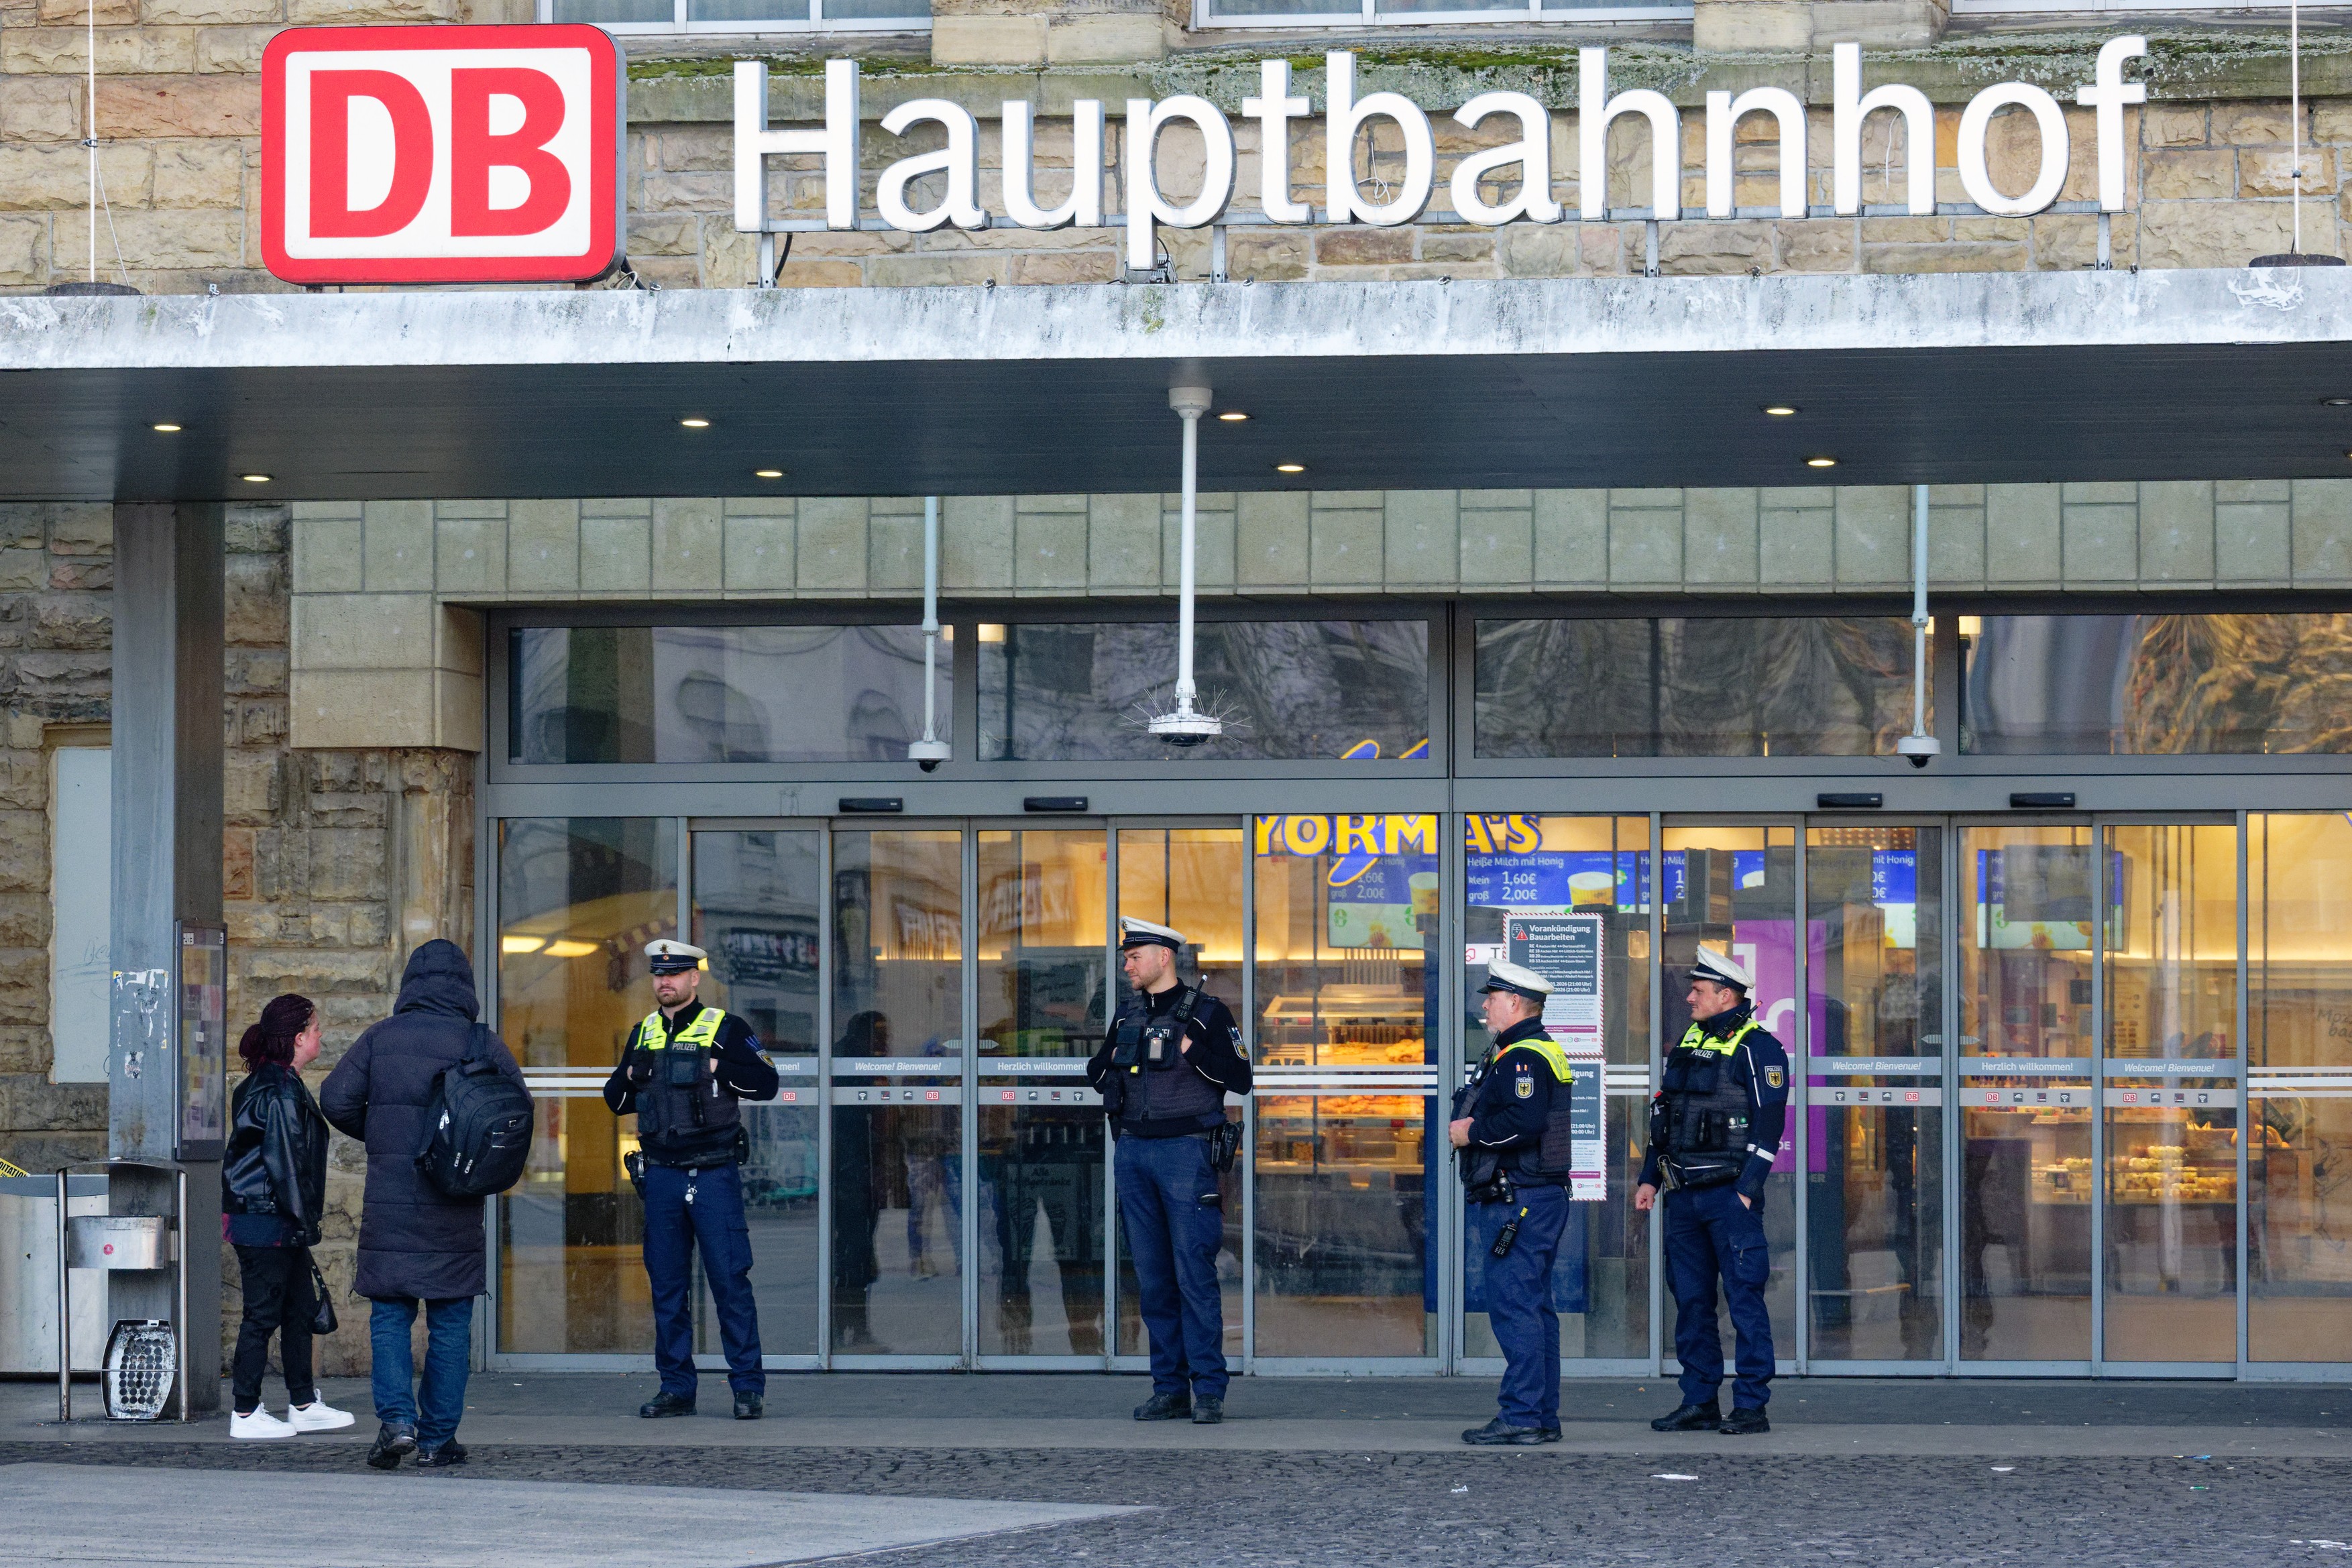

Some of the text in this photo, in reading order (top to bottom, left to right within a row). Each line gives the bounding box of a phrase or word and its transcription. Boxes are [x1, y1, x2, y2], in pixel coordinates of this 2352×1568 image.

[309, 67, 571, 238] DB
[733, 36, 2147, 270] Hauptbahnhof
[1467, 856, 1564, 869] Heiße Milch mit Honig
[1887, 856, 1914, 866] Honig
[1468, 871, 1537, 886] klein 1,60€
[1357, 885, 1385, 899] 2,00€
[1468, 886, 1538, 902] groß 2,00€
[1529, 925, 1591, 934] Vorankündigung
[1529, 933, 1575, 941] Bauarbeiten
[672, 1042, 697, 1052] POLIZEI
[1691, 1048, 1714, 1059] POLIZEI
[855, 1062, 942, 1071] Welcome! Bienvenue!
[997, 1062, 1086, 1071] Herzlich willkommen!
[1832, 1062, 1921, 1071] Welcome! Bienvenue!
[1982, 1062, 2074, 1071] Herzlich willkommen!
[2125, 1064, 2215, 1072] Welcome! Bienvenue!
[785, 1093, 795, 1101] DB
[927, 1092, 938, 1100] DB
[1003, 1092, 1014, 1100] DB
[1907, 1093, 1918, 1101] DB
[1987, 1093, 1999, 1101] DB
[2124, 1094, 2136, 1102] DB
